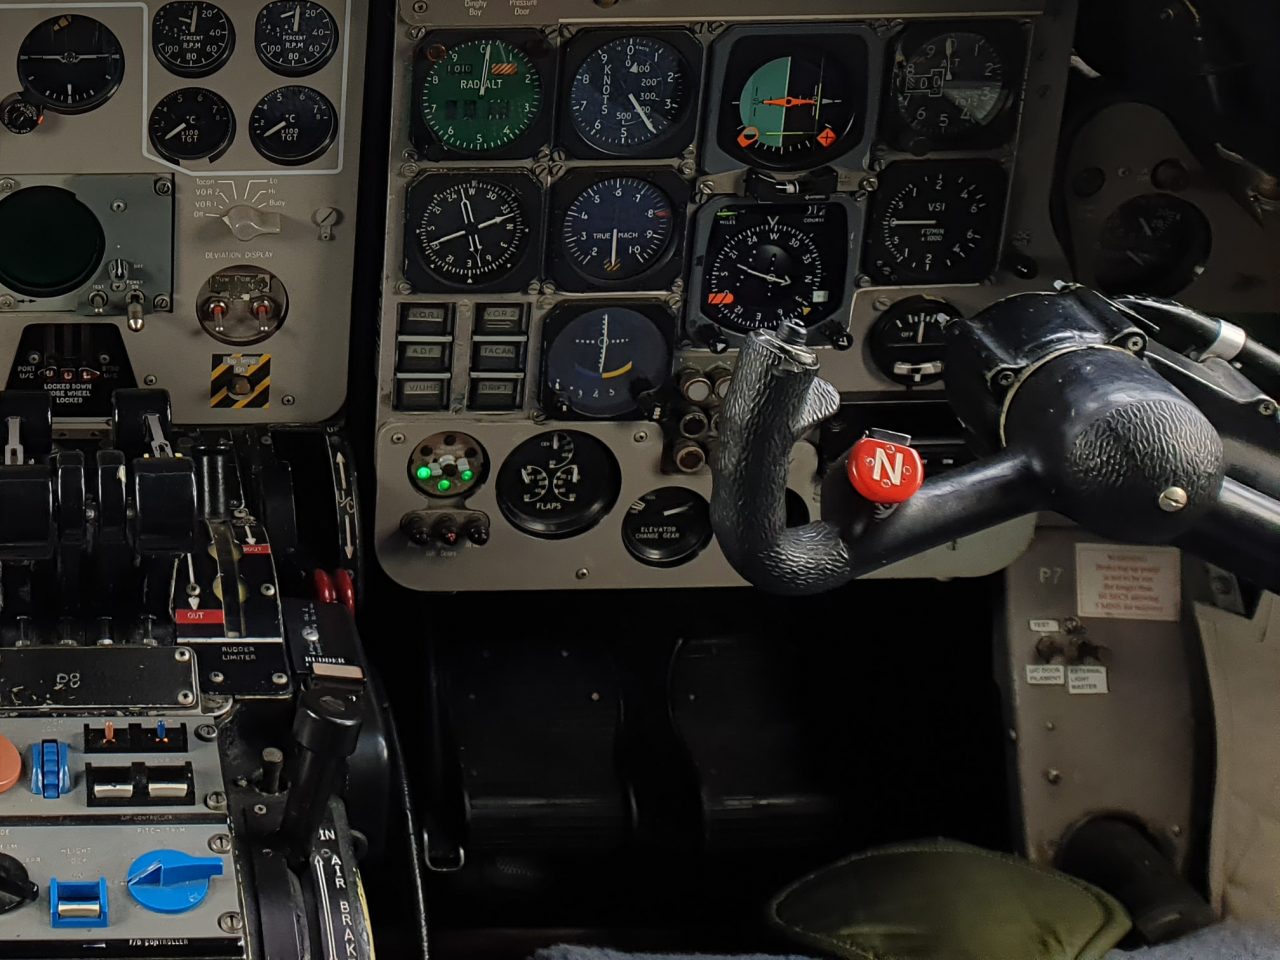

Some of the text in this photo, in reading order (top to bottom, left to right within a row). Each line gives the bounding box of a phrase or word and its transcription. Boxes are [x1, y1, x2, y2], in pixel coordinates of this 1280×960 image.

[514, 7, 531, 17] Door
[460, 78, 504, 90] RAD ALT
[640, 77, 658, 87] 200
[601, 65, 613, 116] KNOTS
[639, 91, 658, 101] 300
[615, 111, 633, 121] 500
[181, 135, 198, 143] TGT
[268, 199, 286, 209] Buoy
[927, 201, 946, 212] VSI
[593, 230, 639, 240] TRUE MACH
[769, 232, 780, 241] W
[204, 251, 274, 260] DEVIATION DISPLAY
[483, 347, 515, 355] TACAN
[17, 365, 36, 373] PORT
[19, 372, 35, 380] U/C
[409, 383, 440, 392] V/UHF
[66, 390, 92, 398] WHEEL
[55, 397, 84, 405] LOCKED
[871, 446, 906, 487] N
[536, 501, 562, 511] FLAPS
[640, 525, 677, 534] ELEVATOR
[635, 531, 681, 540] CHANGE GEAR
[1038, 566, 1064, 585] P7
[186, 610, 206, 620] OUT
[221, 645, 256, 654] RUDDER
[221, 653, 257, 661] LIMITER
[1070, 667, 1103, 675] EXTERNAL
[319, 828, 336, 841] IN
[330, 854, 347, 889] AIR
[144, 938, 190, 946] CONTROLLER
